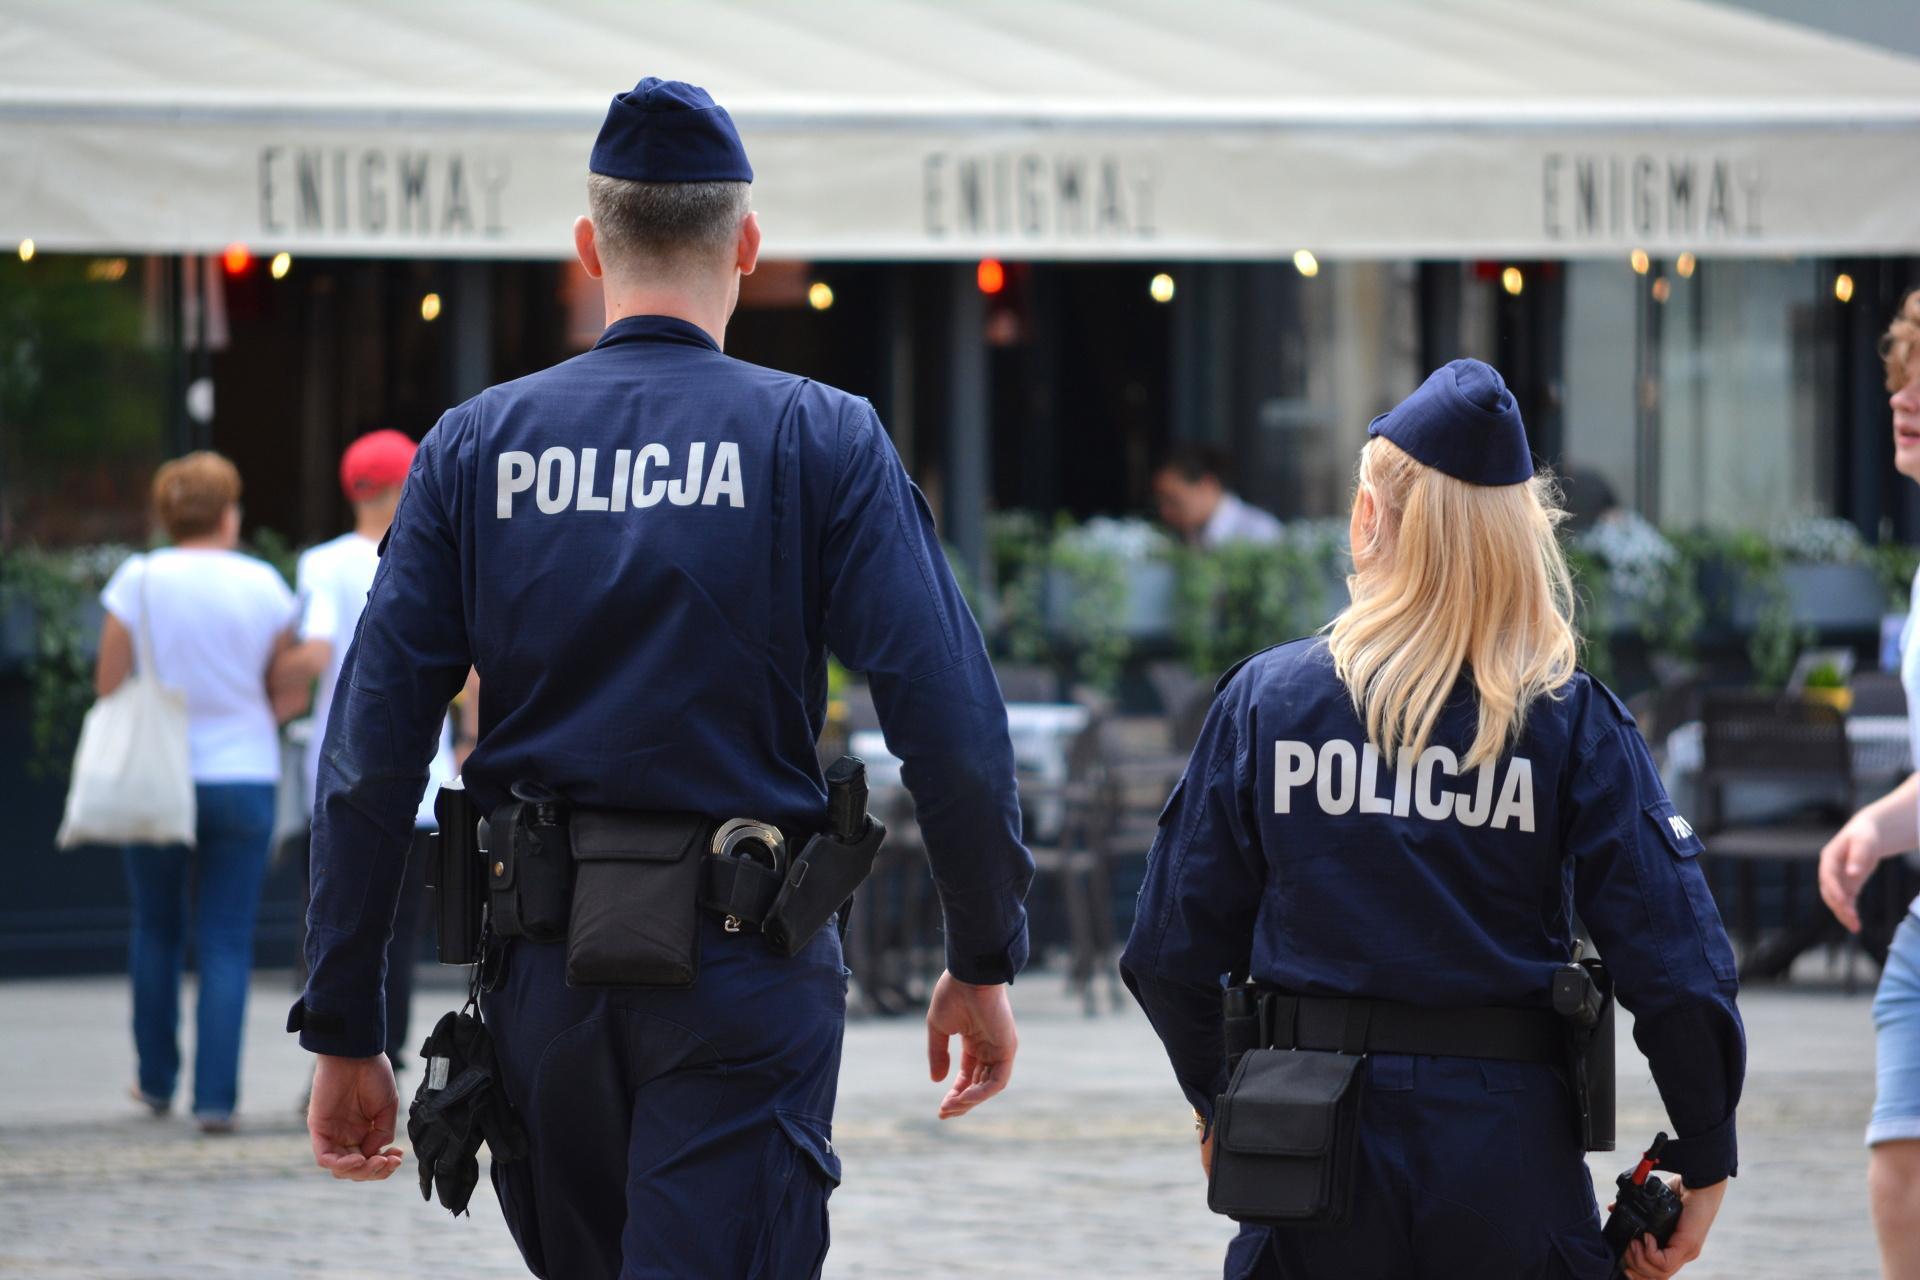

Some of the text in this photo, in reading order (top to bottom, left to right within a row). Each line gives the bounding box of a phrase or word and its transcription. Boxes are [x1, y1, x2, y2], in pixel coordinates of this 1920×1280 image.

[257, 146, 475, 234] ENIGMA
[922, 151, 1132, 240] ENIGMA
[1542, 151, 1737, 240] ENIGMA
[496, 441, 746, 520] POLICJA
[1274, 738, 1536, 833] POLICJA
